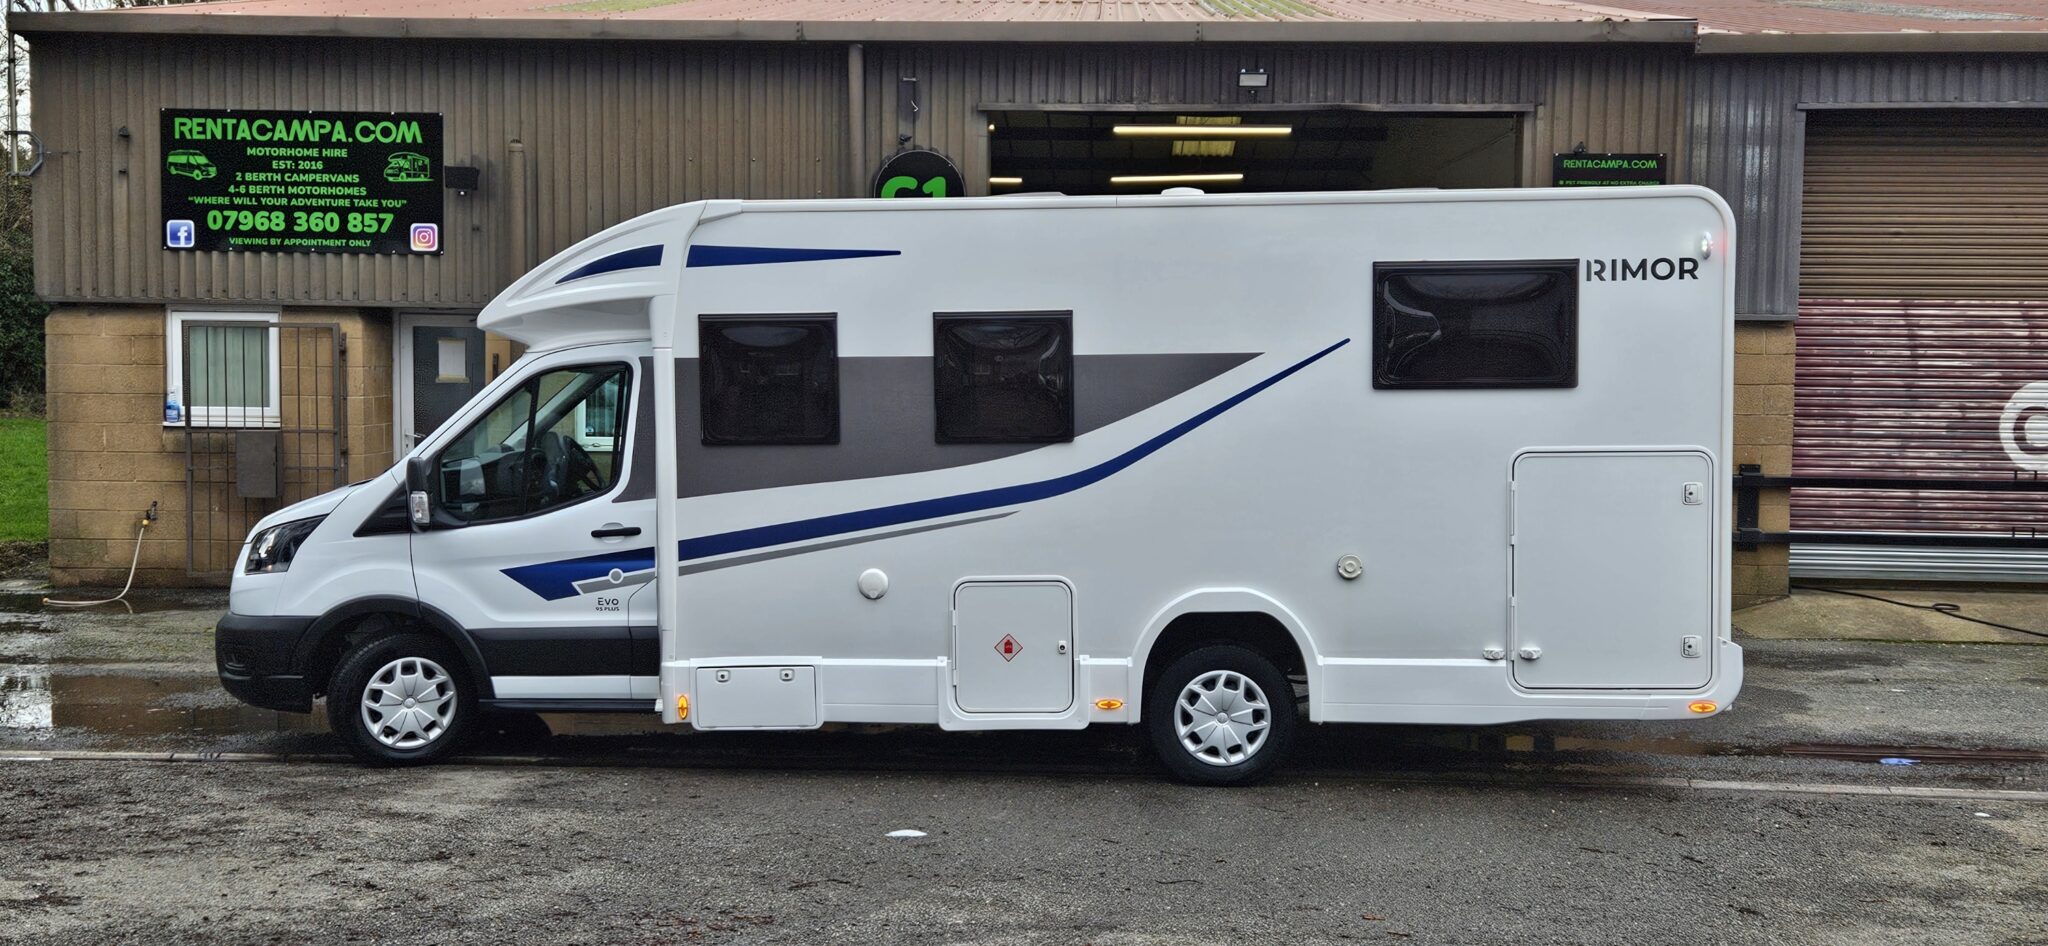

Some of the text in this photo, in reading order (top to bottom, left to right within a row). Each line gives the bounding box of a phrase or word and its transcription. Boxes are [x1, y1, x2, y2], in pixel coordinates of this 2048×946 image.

[174, 117, 423, 144] RENTACAMPA.COM
[246, 147, 348, 158] MOTORHOME HIRE
[272, 160, 323, 170] EST: 2016
[1563, 160, 1657, 169] RENTACAMPA.COM
[235, 172, 360, 183] 2 BERTH CAMPERVANS
[228, 184, 367, 196] 4-6 BERTH MOTORHOMES
[233, 196, 258, 205] WILL
[260, 197, 288, 206] YOUR
[290, 198, 351, 207] ADVENTURE
[353, 199, 379, 208] TAKE
[206, 209, 394, 234] 07968 360 857
[229, 237, 372, 247] VIEWING BY APPOINTMENT ONLY
[1586, 257, 1699, 282] RIMOR
